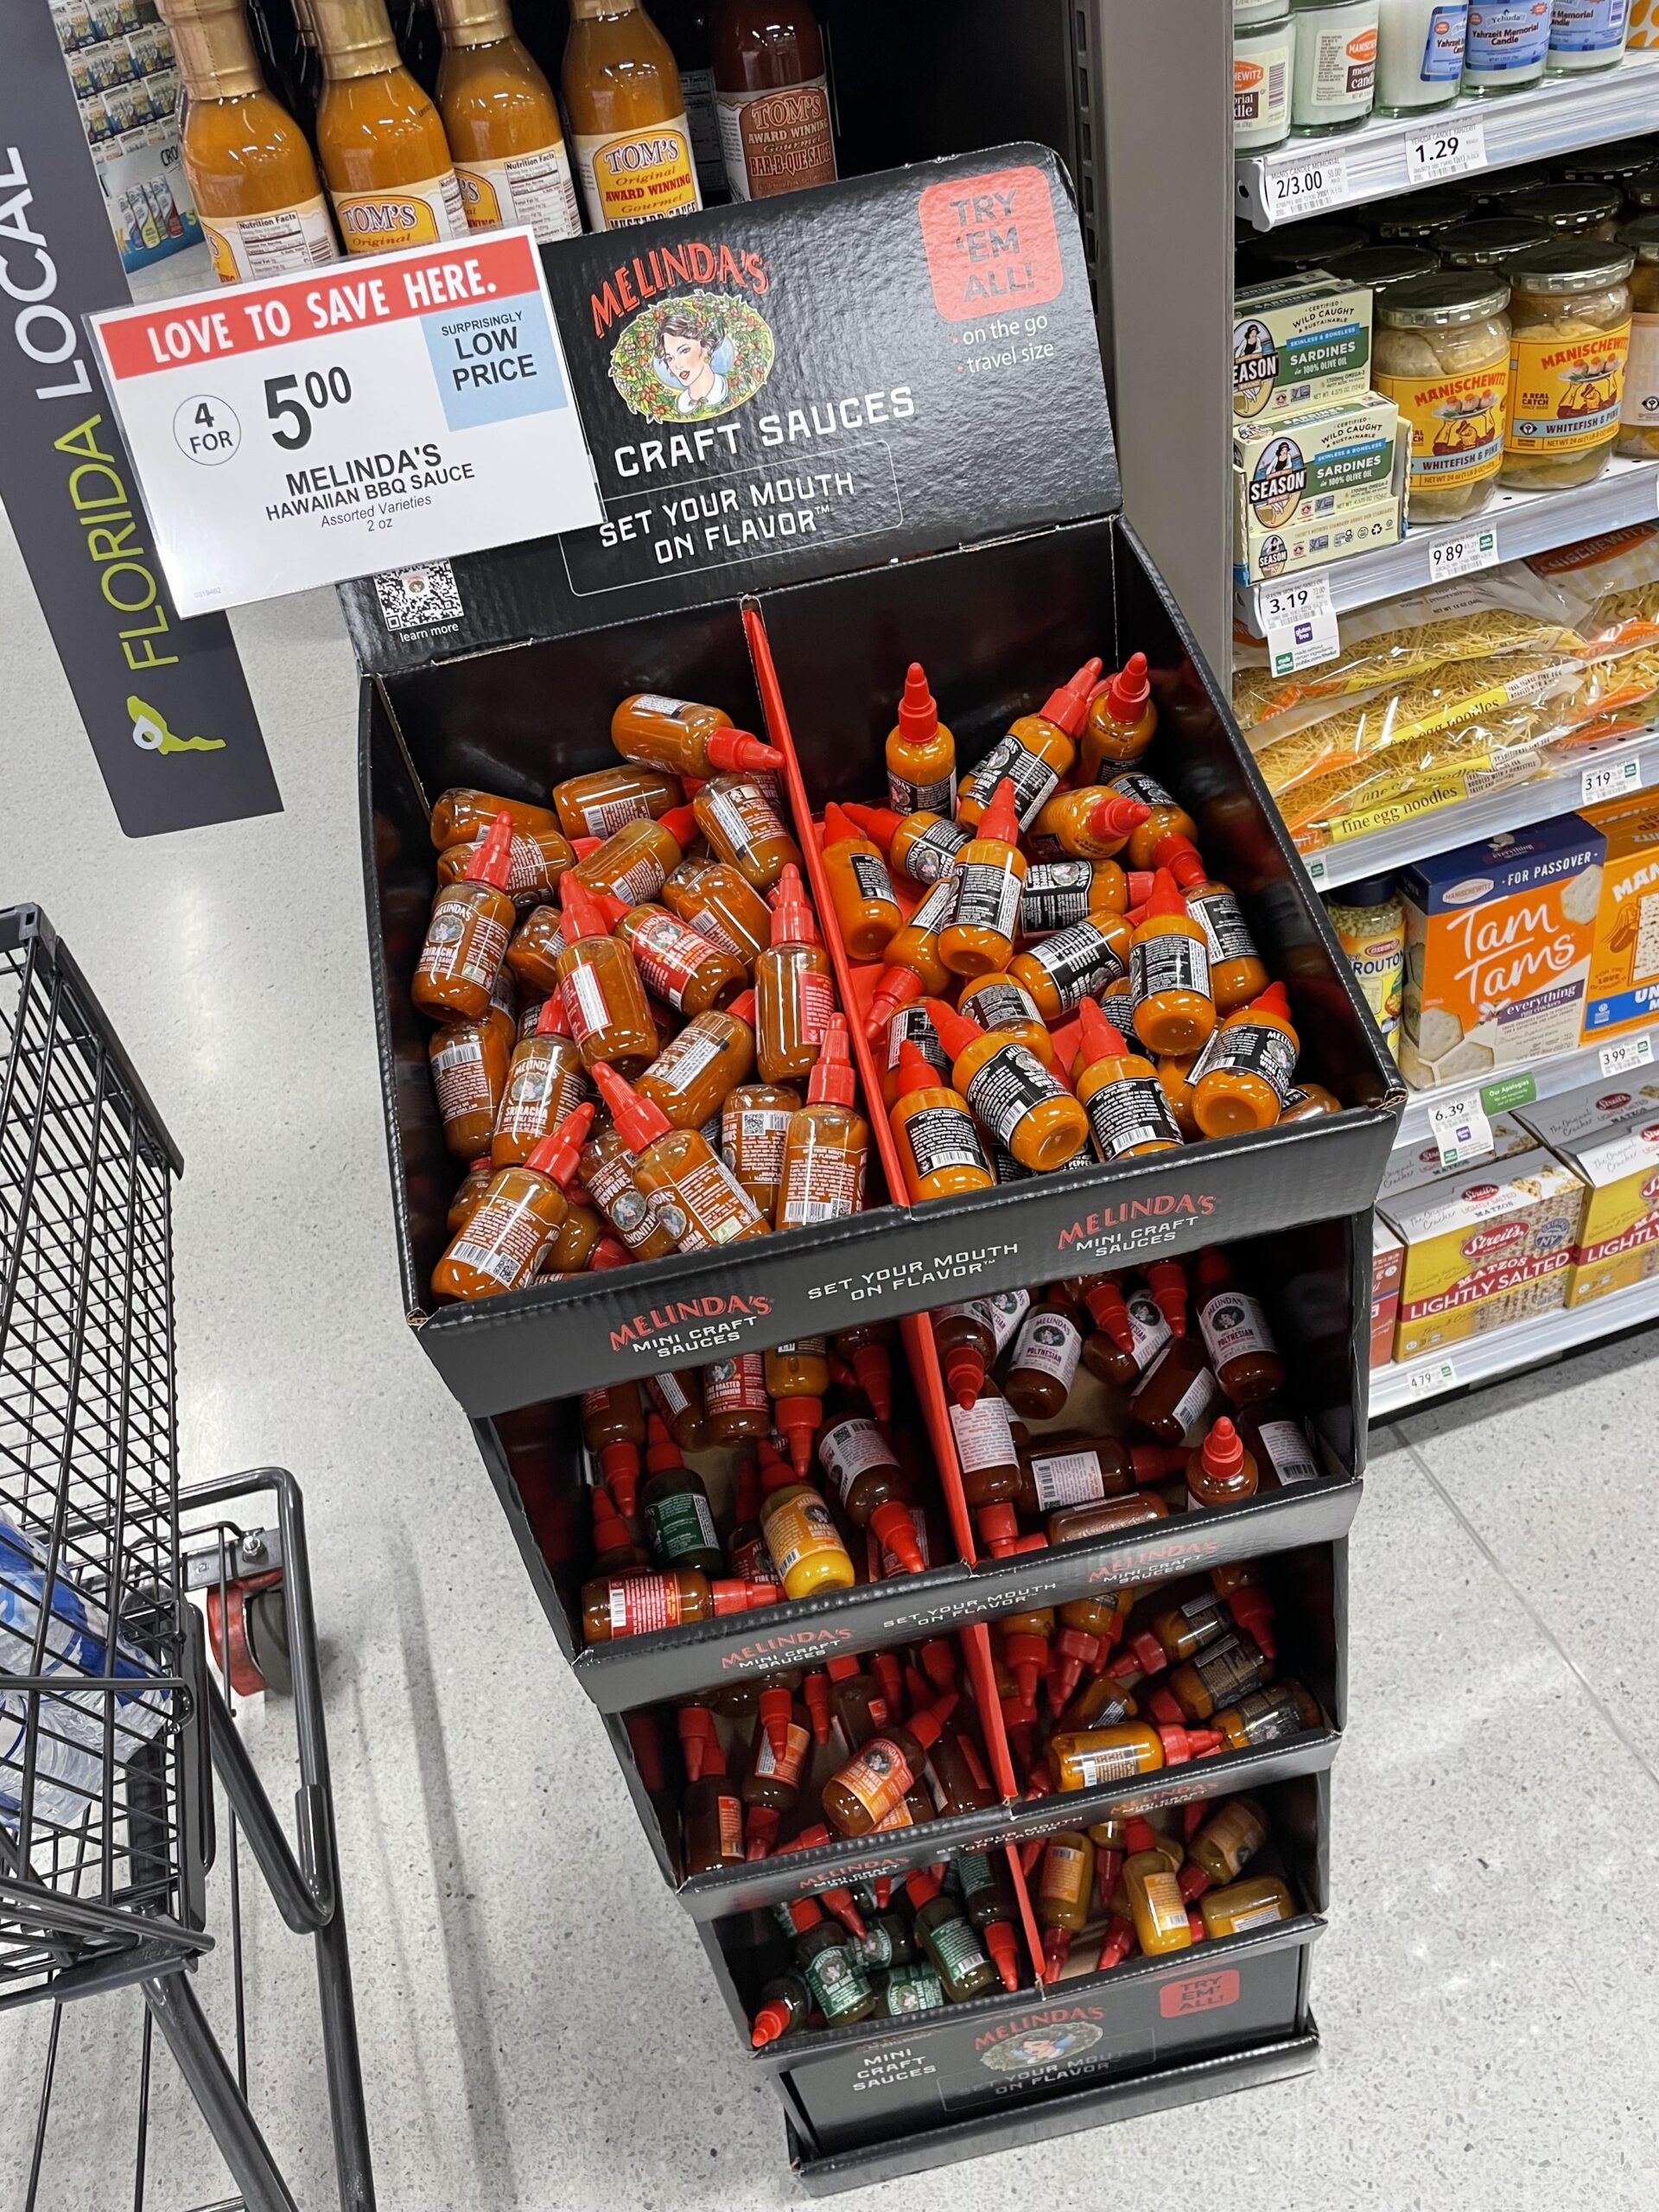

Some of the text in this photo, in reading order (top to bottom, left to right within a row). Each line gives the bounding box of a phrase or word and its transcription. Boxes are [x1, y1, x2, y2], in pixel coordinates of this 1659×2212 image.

[1558, 10, 1593, 19] Memorial
[1472, 22, 1539, 38] Yahrzeit Memorial
[1491, 36, 1519, 45] Candle
[752, 95, 821, 130] TOM'S
[748, 119, 828, 144] AWARD WINNING
[763, 135, 822, 153] Gourmet
[606, 137, 679, 175] TOM'S
[1415, 137, 1459, 162] 1.29
[506, 157, 538, 170] Nutrition
[615, 165, 676, 187] Original
[606, 174, 690, 202] AWARD WINNING
[1277, 171, 1323, 199] 2/3.00
[621, 194, 683, 214] Gourmet
[951, 188, 1019, 229] TRY
[239, 213, 296, 230] Nutrition Facts
[345, 204, 417, 235] TOM'S
[352, 232, 411, 247] Original
[589, 242, 772, 339] MELINDA'S
[963, 263, 1036, 302] ALL!
[147, 258, 497, 364] LOVE TO SAVE HERE.
[1293, 308, 1355, 328] WILD CAUGHT
[1309, 301, 1339, 312] CERTIFIED
[441, 310, 523, 337] SURPRISINGLY
[962, 315, 1049, 346] on the go
[1305, 317, 1348, 331] SUSTAINABLE
[454, 327, 519, 360] LOW
[1290, 327, 1356, 347] SKINLESS BONELESS
[966, 342, 1055, 375] travel size
[1290, 341, 1356, 366] SARDINES
[1303, 357, 1347, 375] 100% OLIVE OIL
[451, 353, 537, 392] PRICE
[1414, 372, 1507, 408] MANISCHEWITZ
[194, 402, 215, 429] 4
[1337, 416, 1367, 429] CERTIFIED
[1546, 420, 1598, 434] WHITEFISH
[188, 430, 233, 454] FOR
[613, 386, 916, 478] CRAFT SAUCES
[1321, 424, 1382, 444] WILD CAUGHT
[1331, 433, 1376, 445] SUSTAINABLE
[1318, 442, 1382, 461] SKINLESS BONELESS
[1423, 444, 1498, 471] WHITEFISH PIKE
[285, 443, 442, 497] MELINDA'S
[1317, 455, 1381, 479] SARDINES
[1329, 469, 1372, 486] 100% OLIVE OIL
[265, 463, 475, 521] HAWAIIAN BBQ SAUCE
[1250, 473, 1306, 501] SEASON
[321, 494, 432, 529] Assorted Varieties
[599, 471, 855, 548] SET YOUR MOUTH
[367, 519, 393, 532] 2 oz
[54, 414, 180, 671] FLORIDA
[655, 536, 696, 565] ON
[1433, 543, 1463, 565] 9.89
[1259, 551, 1287, 568] SEASON
[1269, 590, 1308, 614] 3.19
[400, 623, 459, 642] learn more
[1341, 785, 1458, 834] fine egg noodles
[1508, 851, 1591, 886] FOR PASSOVER
[1446, 903, 1559, 960] Tam
[1454, 931, 1576, 1005] Tams
[1506, 985, 1576, 1015] everything
[1501, 1079, 1529, 1094] Apologies
[1435, 1103, 1465, 1121] 6.39
[1465, 1185, 1498, 1201] Streit's
[1474, 1201, 1514, 1217] MATZOS
[1055, 1194, 1217, 1251] MELINDA'S
[1076, 1216, 1200, 1253] MINI CRAFT
[1095, 1231, 1179, 1258] SAUCES
[1464, 1224, 1525, 1255] Streit's
[1539, 1235, 1561, 1247] NY
[807, 1243, 1020, 1300] SET YOUR MOUTH
[1458, 1256, 1528, 1288] MATZOS
[849, 1281, 886, 1302] ON
[1410, 1278, 1495, 1319] LIGHTLY
[1497, 1253, 1570, 1290] SALTED
[609, 1295, 772, 1352] MELINDA'S
[632, 1316, 758, 1352] MINI CRAFT
[658, 1332, 741, 1357] SAUCES
[1103, 1554, 1204, 1583] MINI CRAFT
[1119, 1564, 1185, 1584] SAUCES
[883, 1583, 1057, 1629] SET YOUR MOUTH
[918, 1613, 944, 1626] ON
[721, 1628, 852, 1669] MELINDA'S
[738, 1639, 842, 1669] MINI CRAFT
[758, 1649, 827, 1669] SAUCES
[1027, 1816, 1083, 1833] MOUTH
[973, 2006, 1108, 2051] MELINDA'S
[856, 2056, 926, 2079] CRAFT
[864, 2048, 912, 2067] MINI
[852, 2064, 937, 2092] SAUCES
[1004, 2063, 1058, 2083] YOUR
[995, 2081, 1024, 2095] ON
